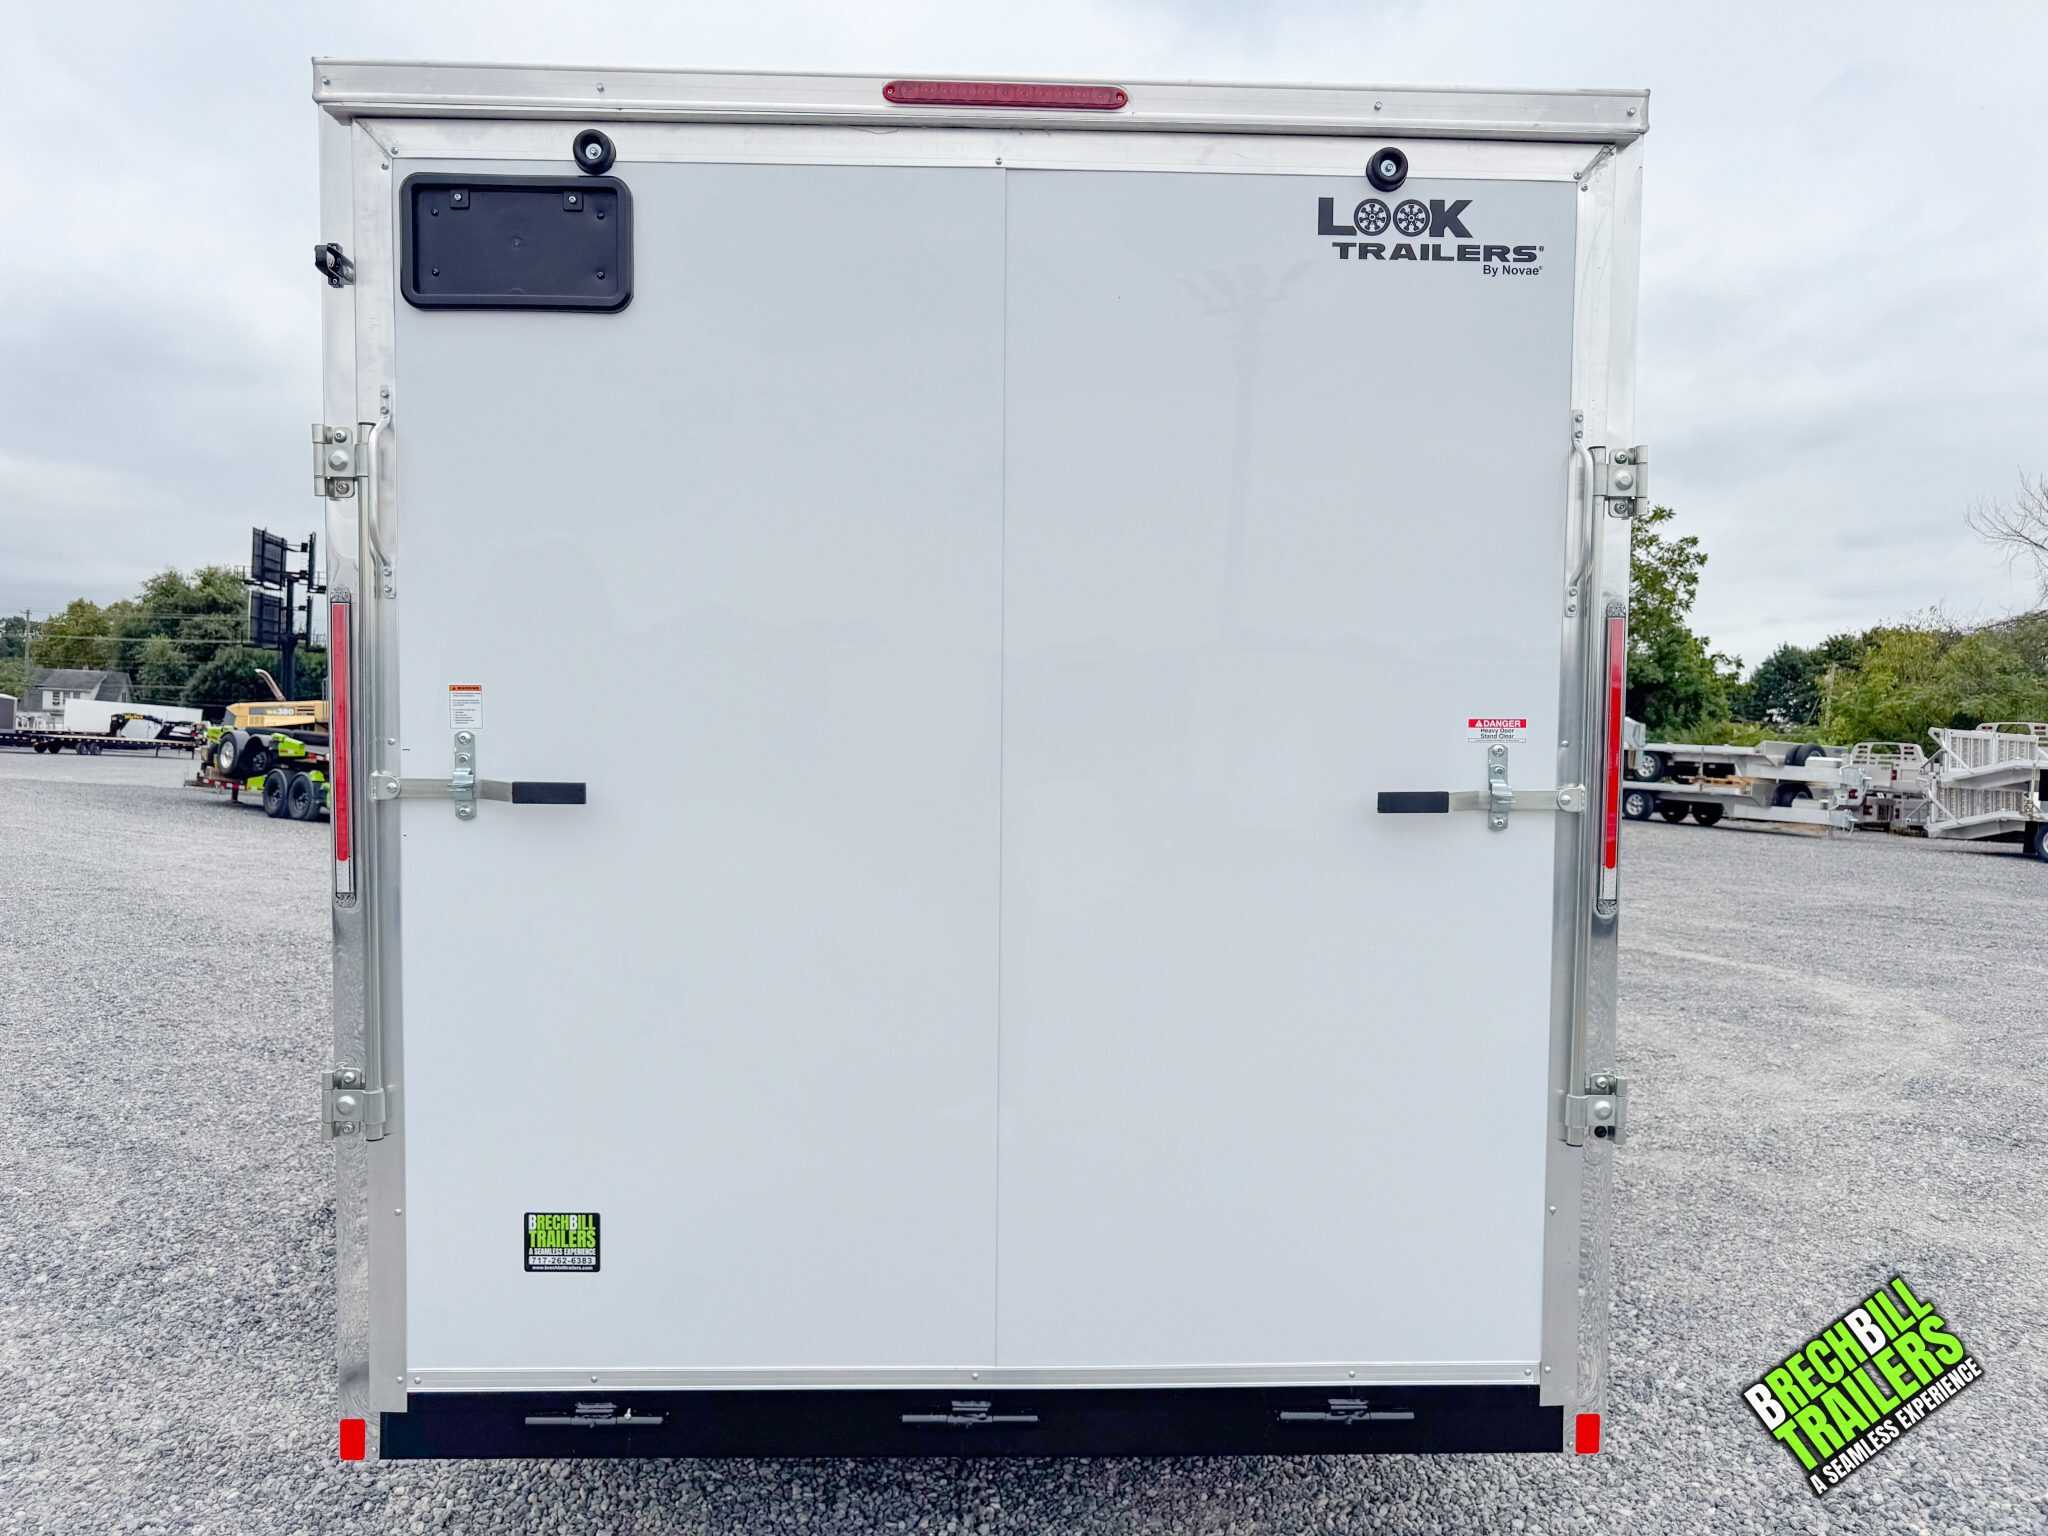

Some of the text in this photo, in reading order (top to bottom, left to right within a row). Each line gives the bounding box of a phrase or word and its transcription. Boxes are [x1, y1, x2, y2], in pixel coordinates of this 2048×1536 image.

[1318, 197, 1473, 238] LOOK
[1332, 242, 1537, 262] TRAILERS
[1483, 264, 1539, 277] By Novae
[1483, 720, 1521, 728] DANGER
[528, 1230, 596, 1248] TRAILERS
[528, 1248, 596, 1256] A SEAMLESS EXPERIENCE
